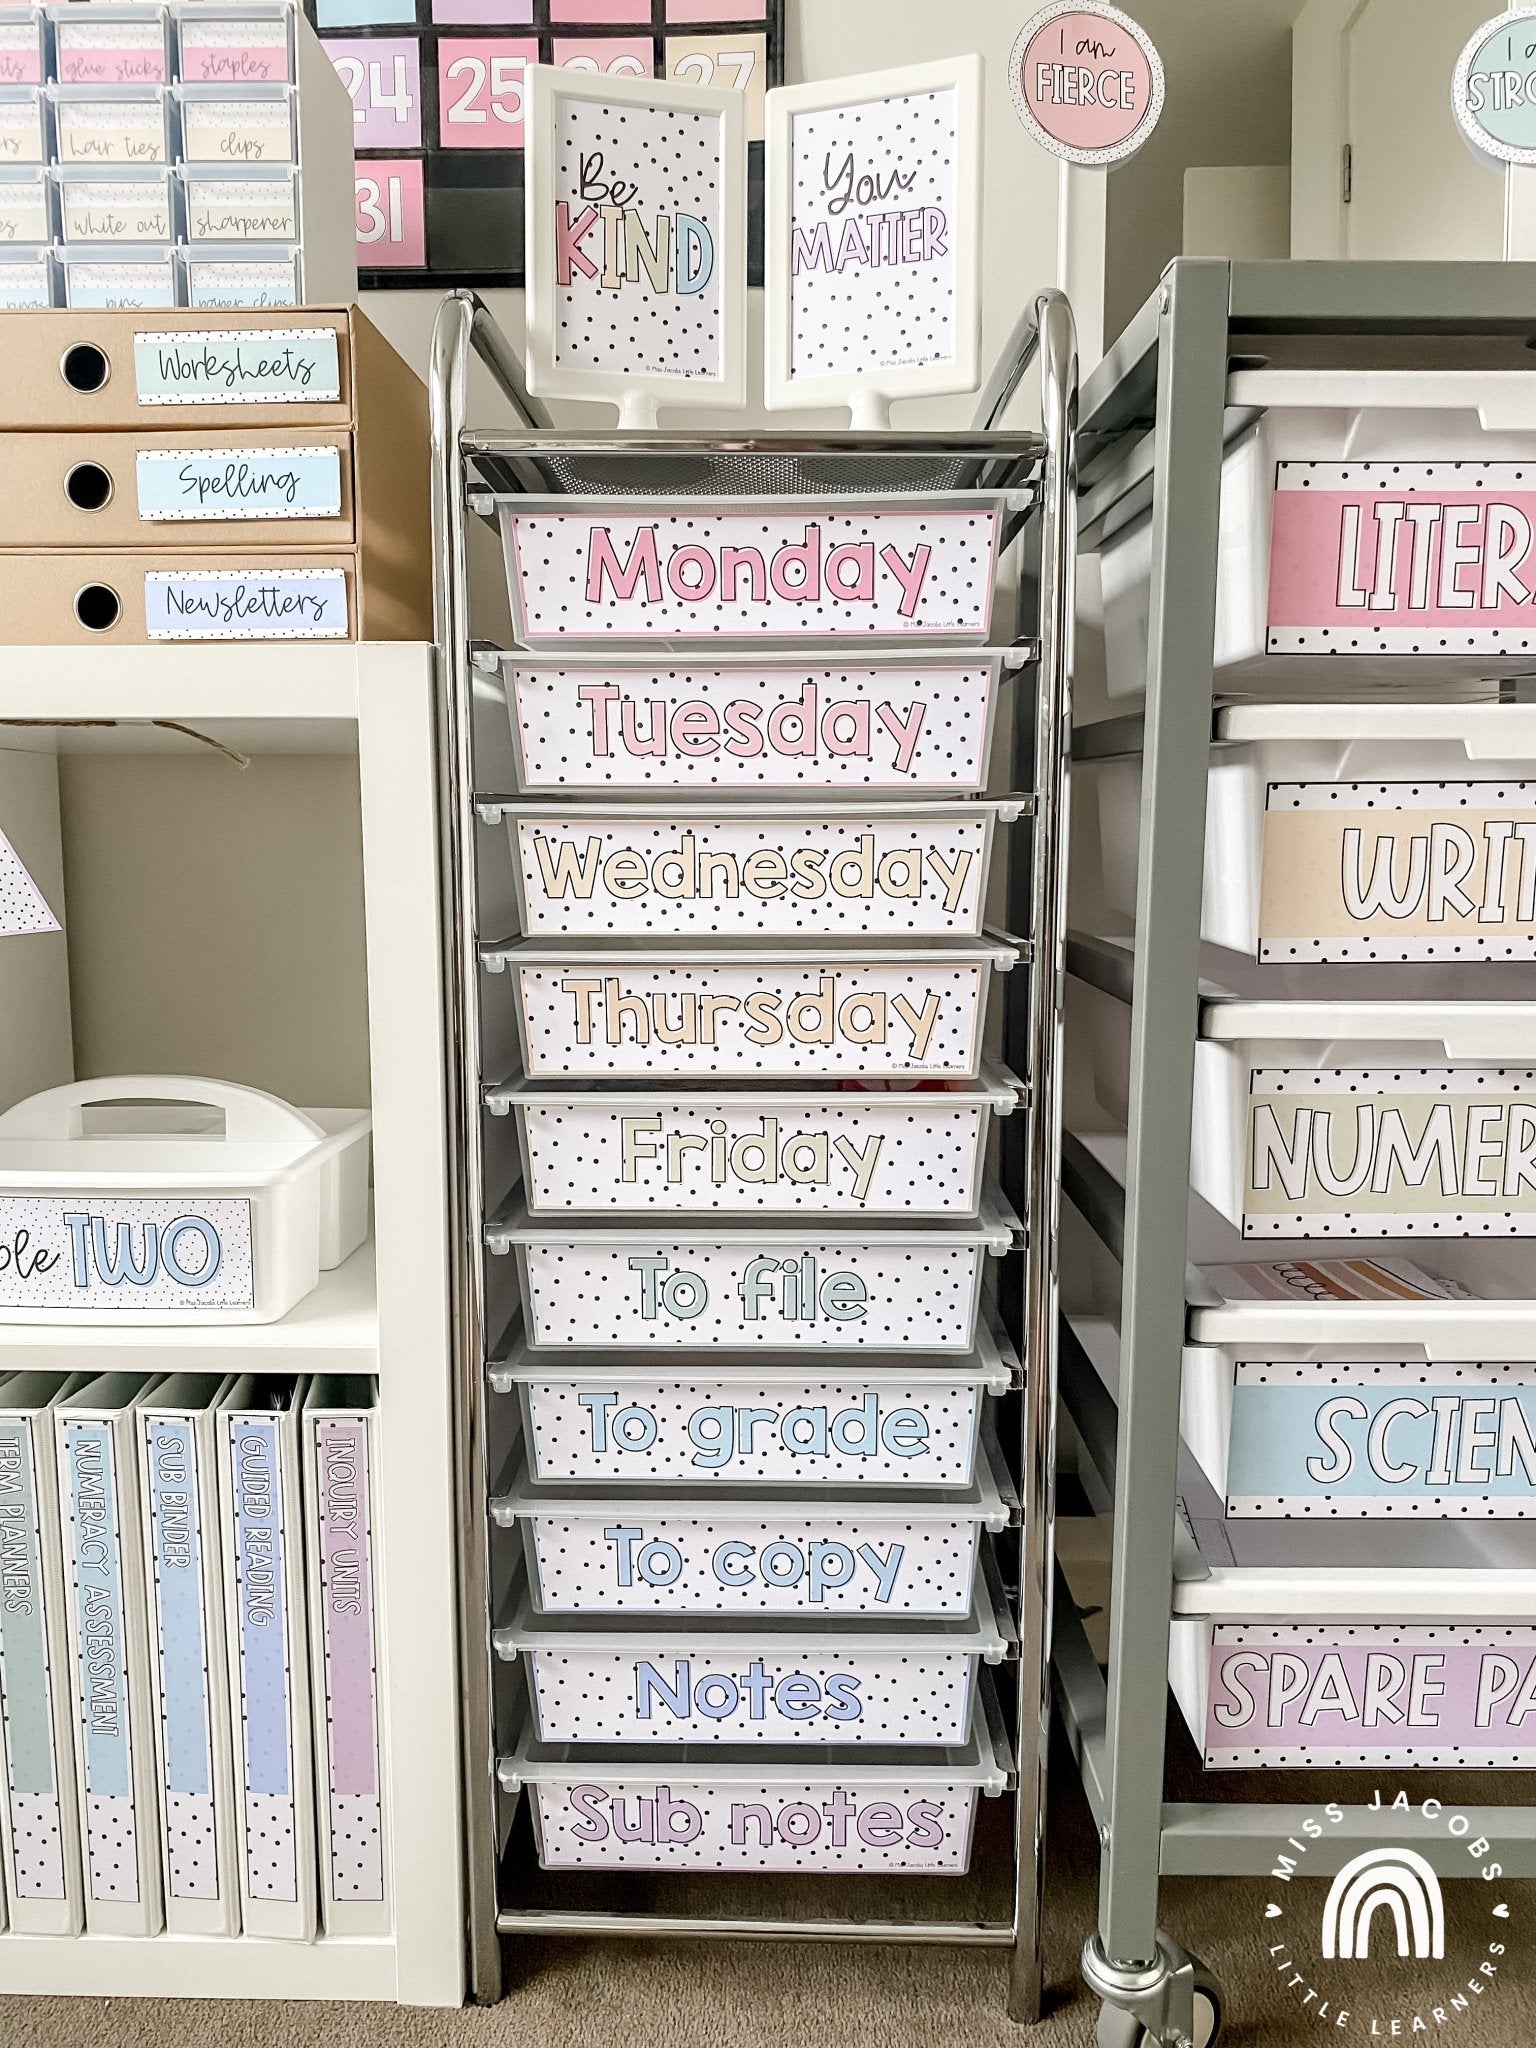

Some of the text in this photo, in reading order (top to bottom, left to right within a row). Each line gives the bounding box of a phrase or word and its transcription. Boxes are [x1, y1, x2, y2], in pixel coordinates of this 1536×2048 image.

[65, 56, 164, 81] glue sticks
[200, 54, 271, 81] staples
[1075, 38, 1116, 59] am
[331, 55, 413, 123] 24
[446, 56, 525, 123] 25
[1035, 62, 1135, 110] FIERCE
[70, 133, 161, 161] hair ties
[220, 132, 265, 158] clips
[579, 151, 638, 207] Be
[355, 176, 403, 243] 31
[823, 152, 916, 215] You
[74, 214, 166, 237] white out
[196, 210, 293, 238] sharpener
[555, 201, 715, 295] KIND
[792, 207, 948, 276] MATTER
[158, 347, 315, 387] Worksheets
[178, 463, 302, 504] Spelling
[585, 525, 932, 618] Monday
[1335, 501, 1536, 610] LITER
[166, 584, 328, 623] Newsletters
[578, 682, 927, 772] Tuesday
[533, 834, 973, 913] Wednesday
[561, 976, 940, 1060] Thursday
[620, 1117, 883, 1199] Friday
[1252, 1104, 1536, 1200] NUMER
[63, 1212, 223, 1289] TWO
[628, 1257, 868, 1321] To file
[578, 1393, 930, 1469] To grade
[0, 1437, 33, 1617] TERM PLANNERS
[156, 1436, 191, 1569] SUB BINDER
[239, 1436, 278, 1627] GUIDED READING
[325, 1438, 362, 1616] INQUIRY UNITS
[74, 1439, 120, 1738] NUMERACY ASSESSMENT
[603, 1527, 905, 1604] To copy
[635, 1660, 863, 1720] Notes
[1214, 1651, 1446, 1728] SPARE
[569, 1784, 945, 1848] Sub notes
